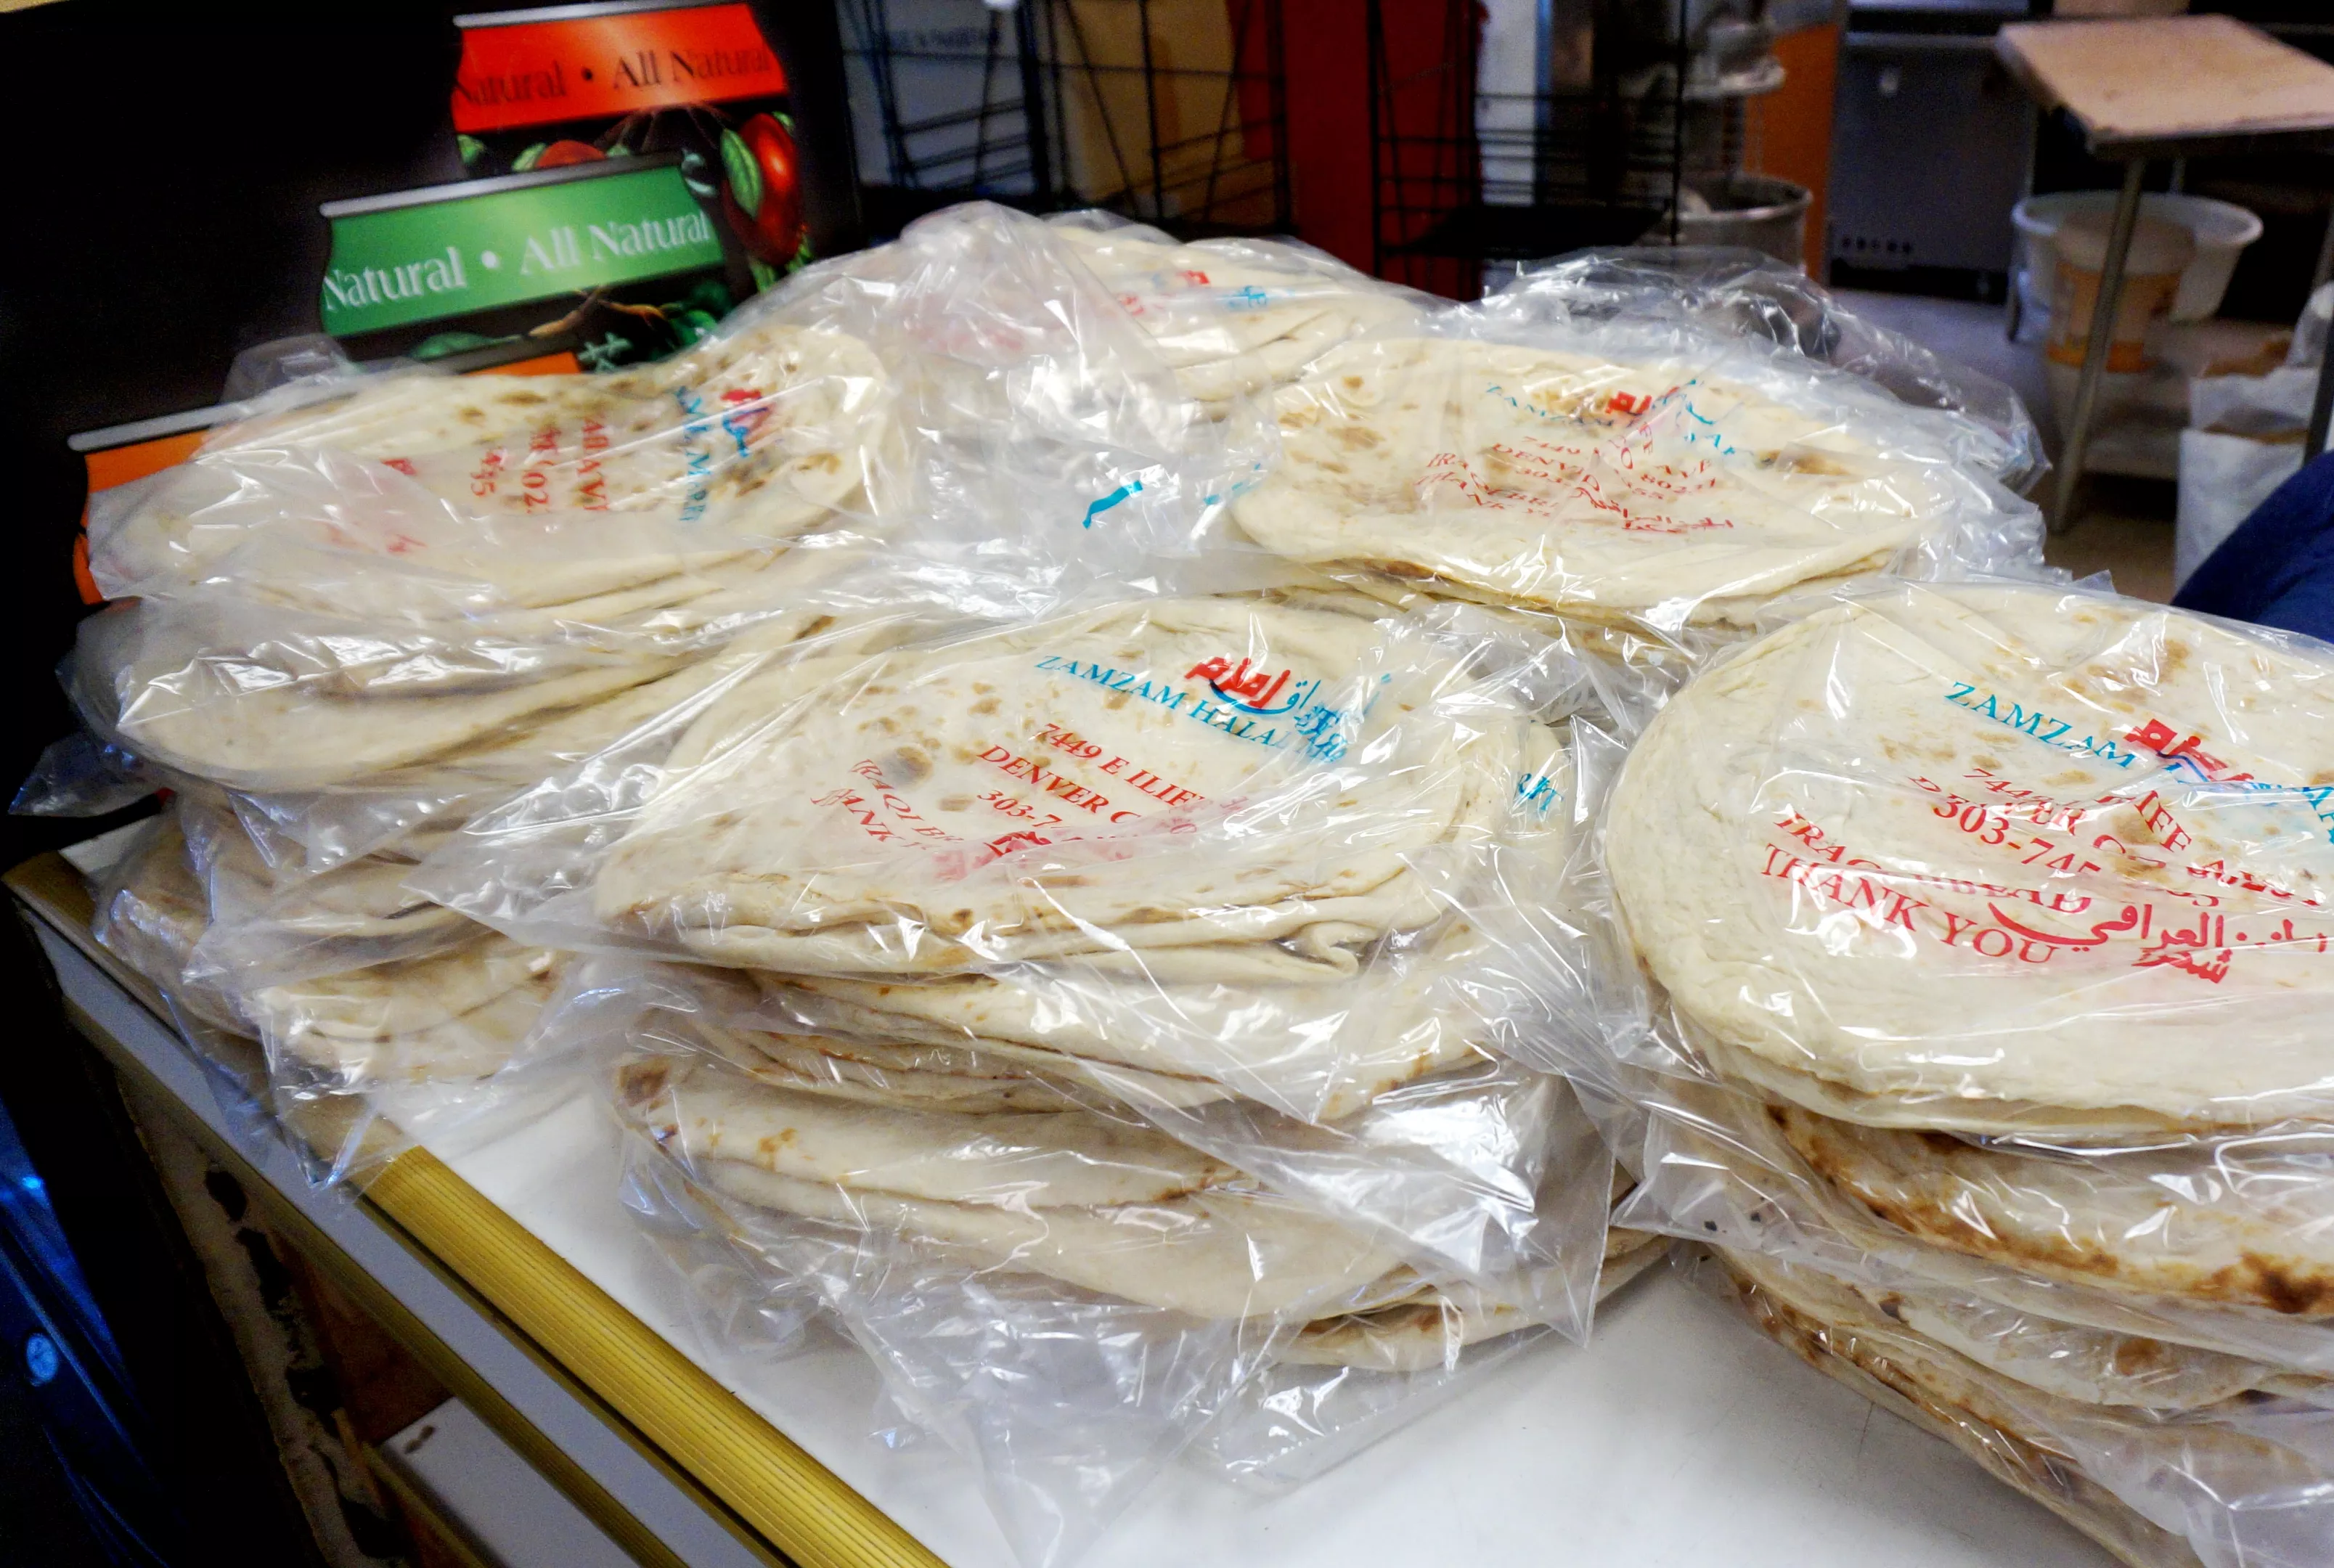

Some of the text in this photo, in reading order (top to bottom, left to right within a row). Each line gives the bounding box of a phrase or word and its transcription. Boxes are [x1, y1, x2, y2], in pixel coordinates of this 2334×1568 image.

[453, 45, 772, 108] Natural All Natural
[324, 209, 711, 311] Natural All Natural
[1033, 655, 1190, 710] ZAMZAM
[1034, 722, 1103, 759] 7449
[1098, 755, 1130, 775] E
[1943, 681, 2137, 769] ZAMZAM
[976, 744, 1142, 824] DENVER C
[976, 789, 1063, 829] 303-7
[1760, 842, 2060, 964] THANK YOU
